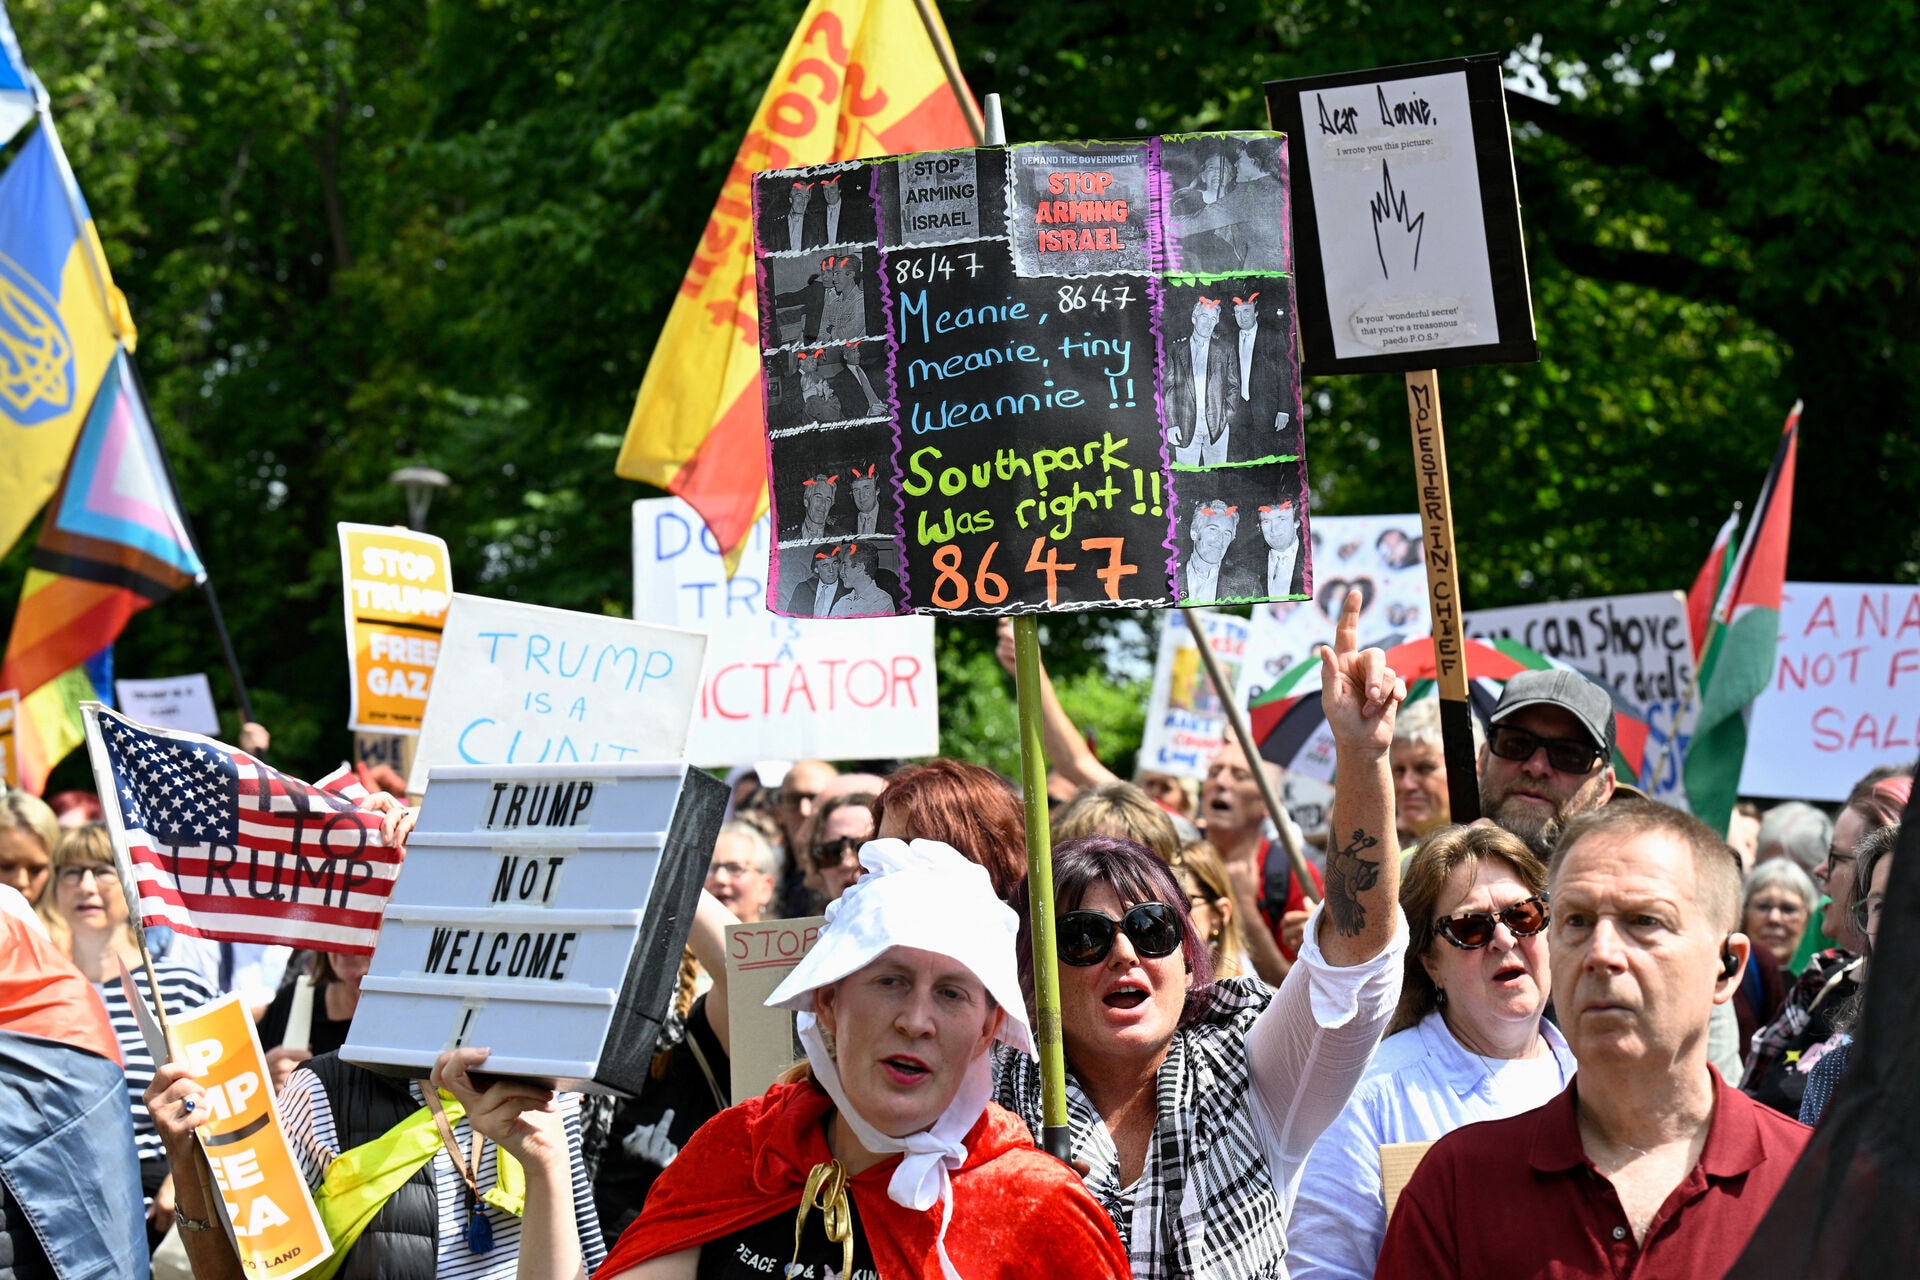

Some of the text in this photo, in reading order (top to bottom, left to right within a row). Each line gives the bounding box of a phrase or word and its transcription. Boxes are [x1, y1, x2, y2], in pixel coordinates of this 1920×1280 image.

[1021, 154, 1138, 165] DEMAND THE GOVERNMENT
[1336, 138, 1434, 156] I wrote you this picture:
[914, 158, 961, 177] STOP
[1047, 172, 1114, 195] STOP
[905, 183, 975, 205] ARMING
[912, 211, 972, 231] ISRAEL
[1035, 199, 1129, 224] ARMING
[1037, 227, 1126, 254] ISRAEL
[899, 289, 1049, 344] Meanie,
[1355, 316, 1364, 324] Is
[1364, 315, 1384, 325] your
[1361, 327, 1377, 335] that
[1377, 325, 1405, 336] you're
[1412, 320, 1458, 331] treasonous
[1058, 331, 1131, 377] tiny
[1382, 335, 1409, 347] paedo
[362, 546, 436, 582] STOP
[352, 579, 448, 617] TRUMP
[769, 620, 801, 640] IS
[1524, 617, 1587, 659] can
[369, 632, 438, 668] FREE
[477, 632, 674, 693] TRUMP
[775, 642, 795, 661] A
[367, 667, 430, 700] GAZ
[1778, 647, 1870, 692] NOT
[700, 655, 922, 720] ICTATOR
[524, 691, 587, 722] IS A
[1811, 706, 1920, 752] SAL
[486, 781, 593, 829] TRUMP
[274, 811, 368, 860] TO
[159, 832, 374, 909] TRUMP
[491, 856, 564, 903] NOT
[425, 927, 576, 981] WELCOME
[731, 927, 819, 960] STOP
[802, 1264, 815, 1280] &
